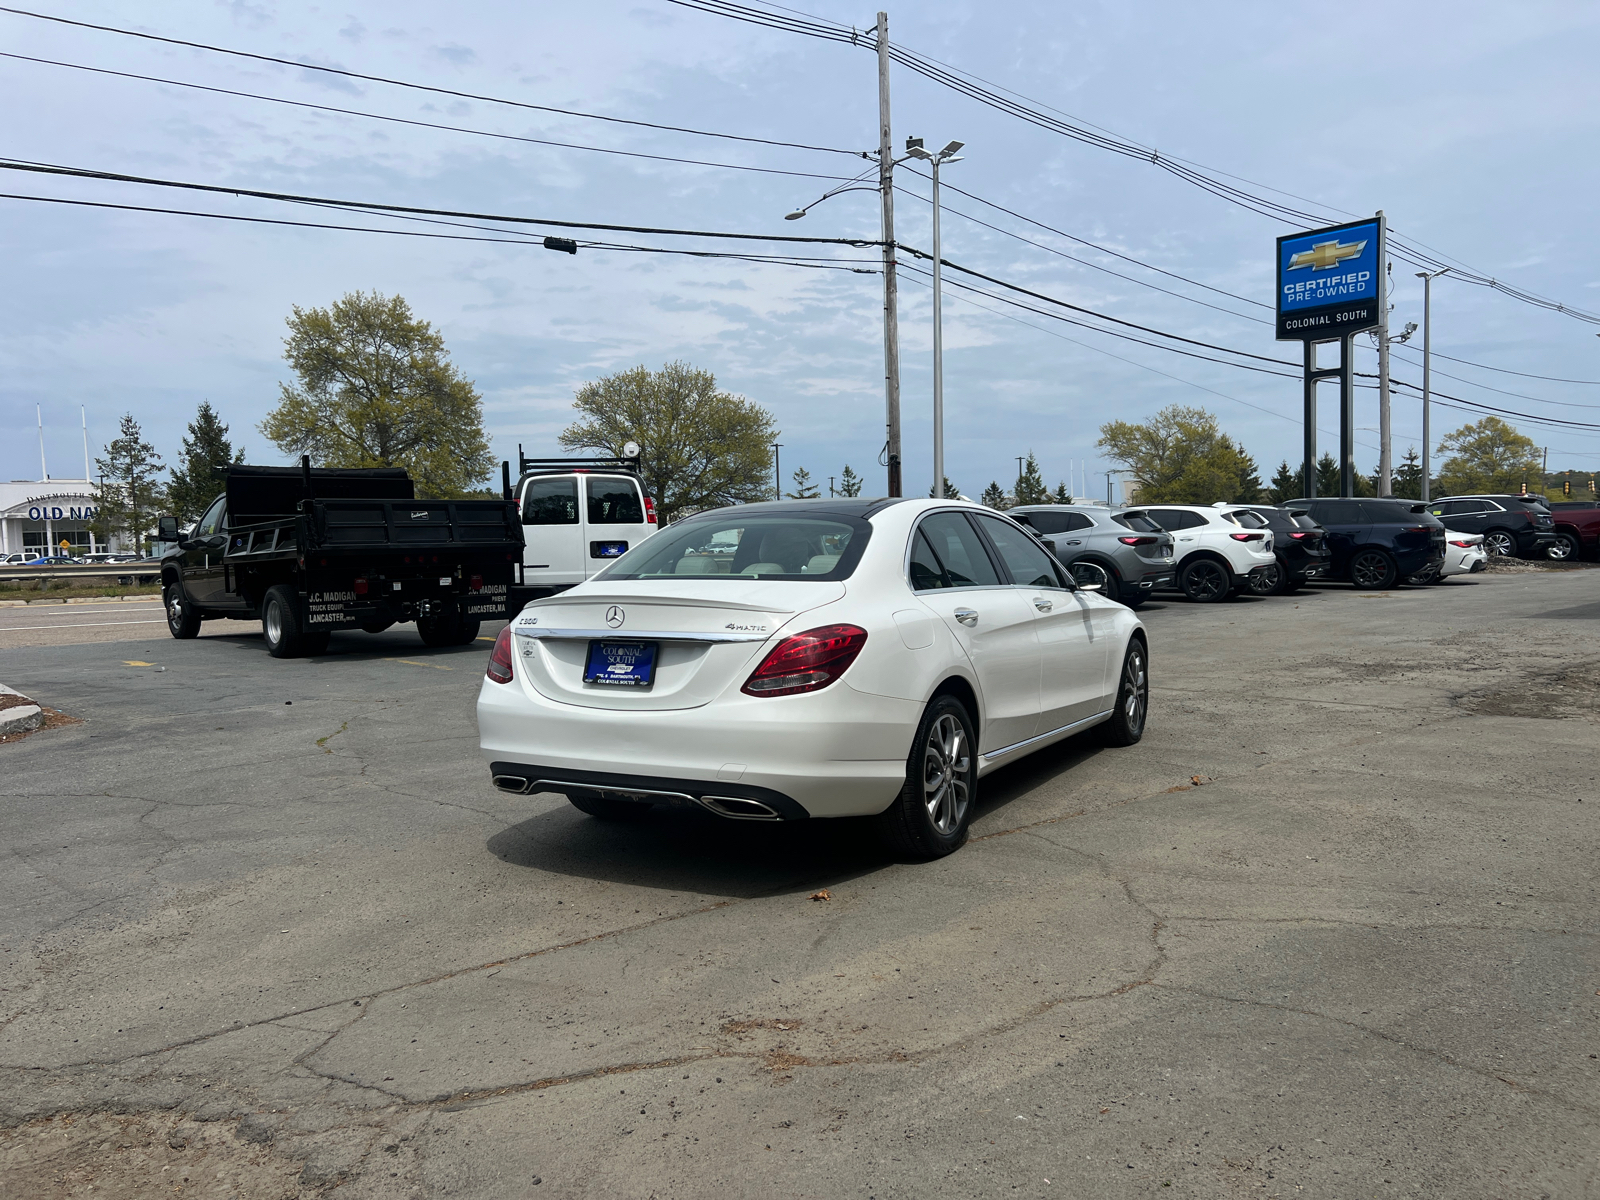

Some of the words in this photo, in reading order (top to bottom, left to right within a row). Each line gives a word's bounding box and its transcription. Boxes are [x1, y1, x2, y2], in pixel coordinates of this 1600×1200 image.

[1284, 271, 1370, 294] CERTIFIED
[1288, 282, 1365, 303] PRE-OWNED
[1286, 315, 1331, 329] COLONIAL
[1336, 309, 1367, 322] SOUTH
[26, 492, 85, 503] DARTMOUTH
[29, 507, 63, 520] OLD
[70, 507, 99, 520] NA
[480, 585, 507, 594] MADIGAN
[309, 592, 322, 602] J.C.
[323, 591, 357, 601] MADIGAN
[725, 622, 767, 631] 4MATIC
[602, 647, 642, 656] COLONIAL
[607, 655, 636, 664] SOUTH
